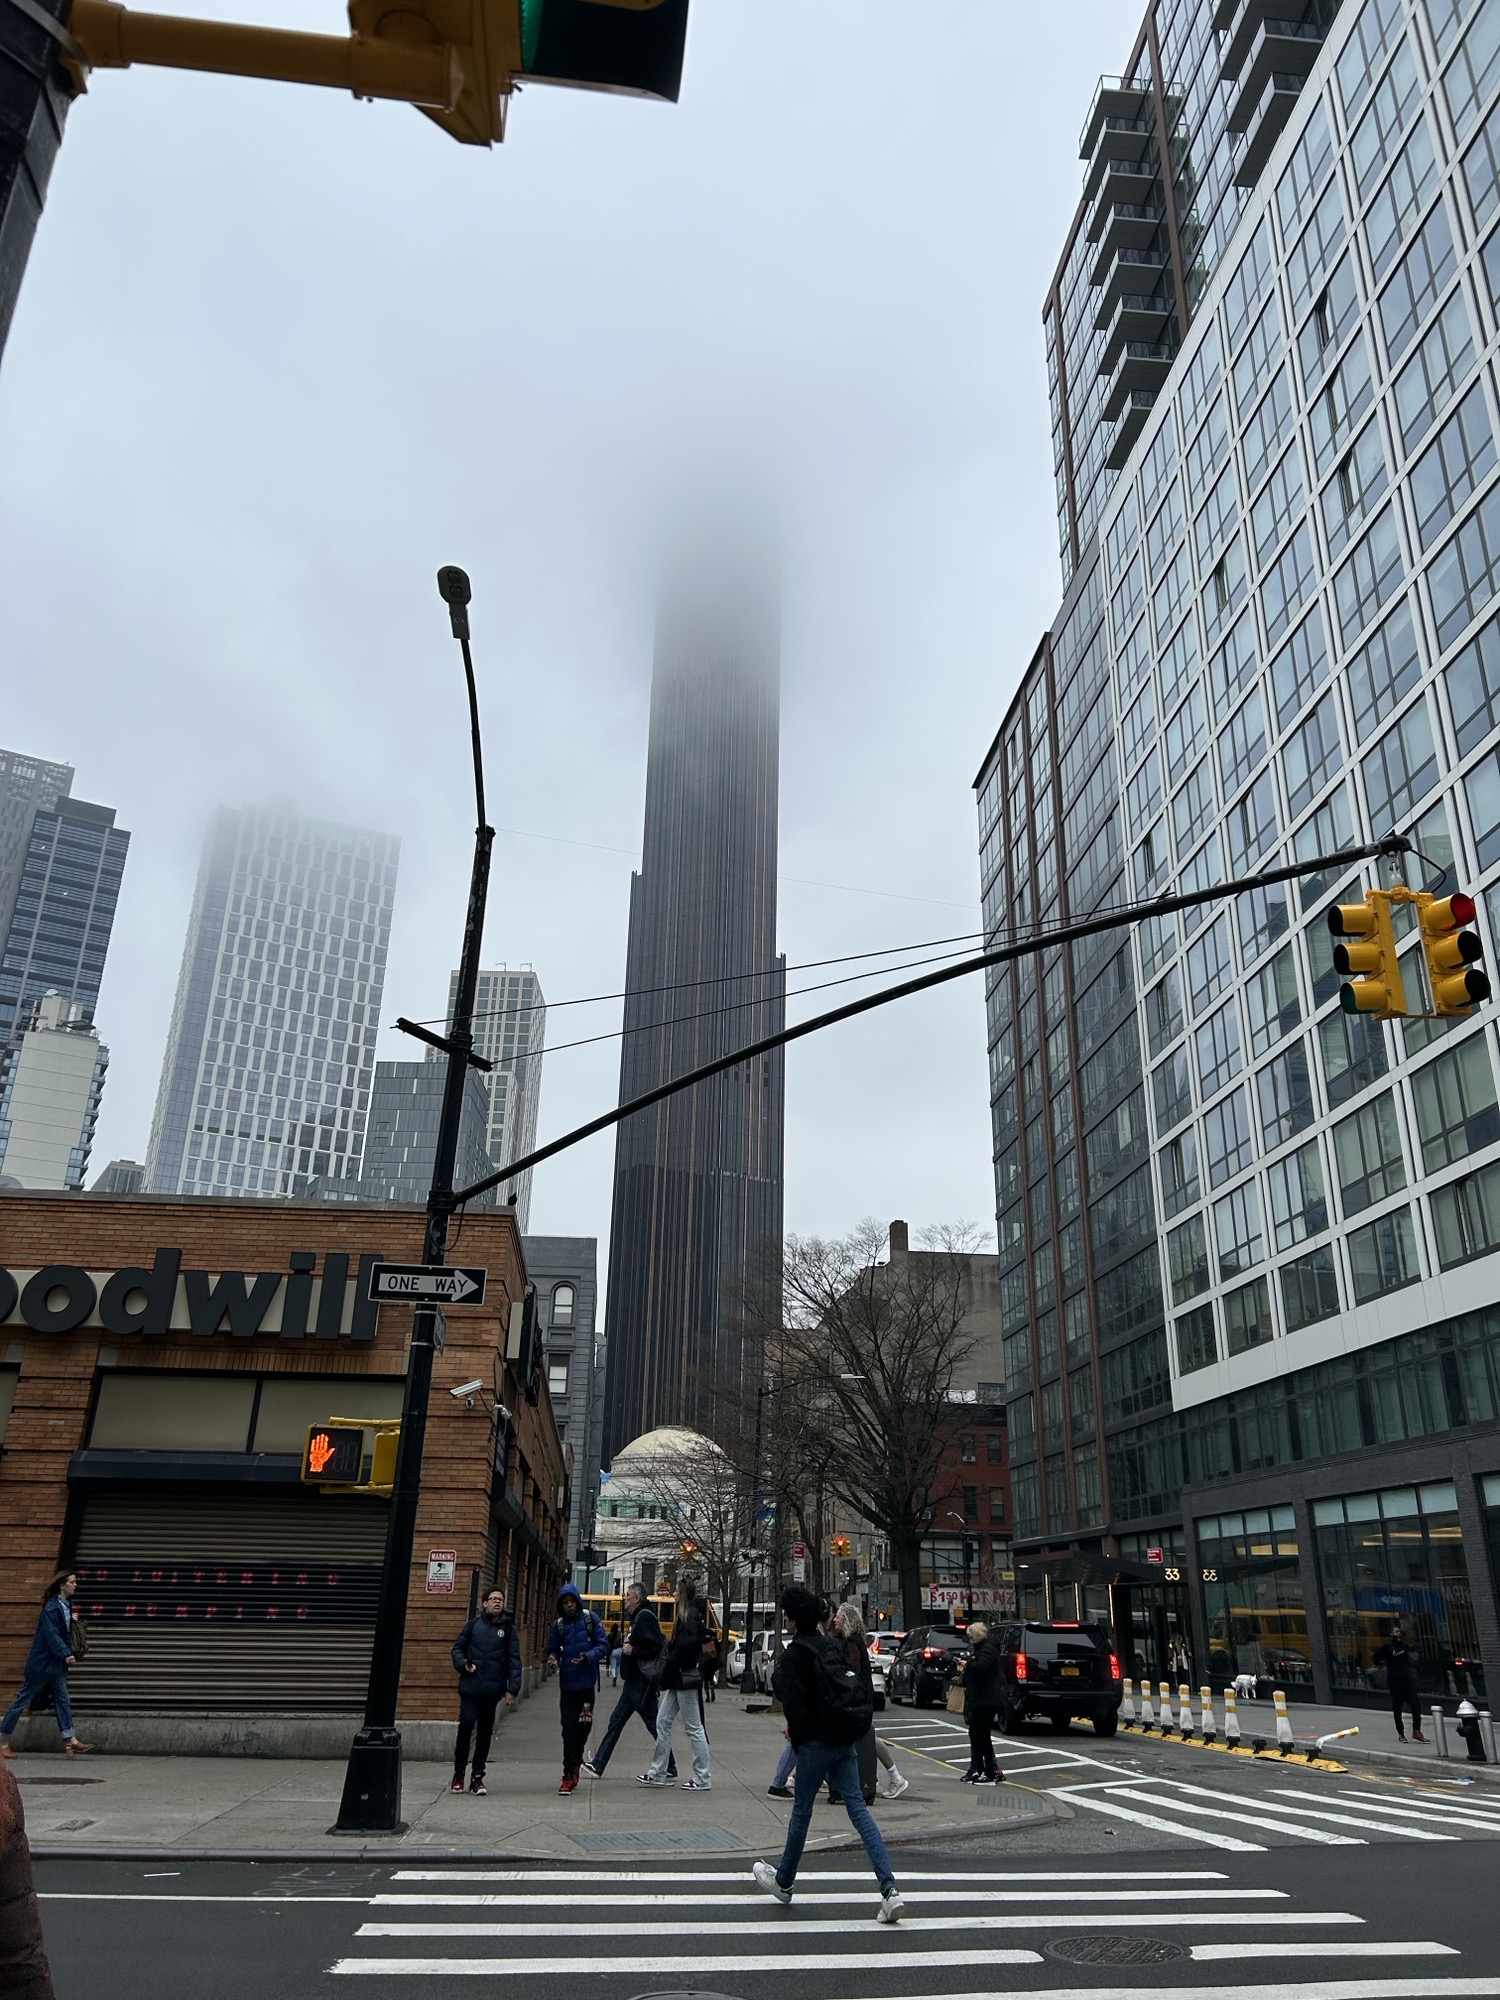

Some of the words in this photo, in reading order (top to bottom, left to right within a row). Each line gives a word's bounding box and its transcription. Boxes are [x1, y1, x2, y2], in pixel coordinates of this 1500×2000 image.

[387, 1276, 420, 1291] ONE
[435, 1278, 468, 1293] WAY
[0, 1248, 383, 1340] odwill
[1165, 1568, 1180, 1581] 33
[960, 1591, 989, 1604] HOT
